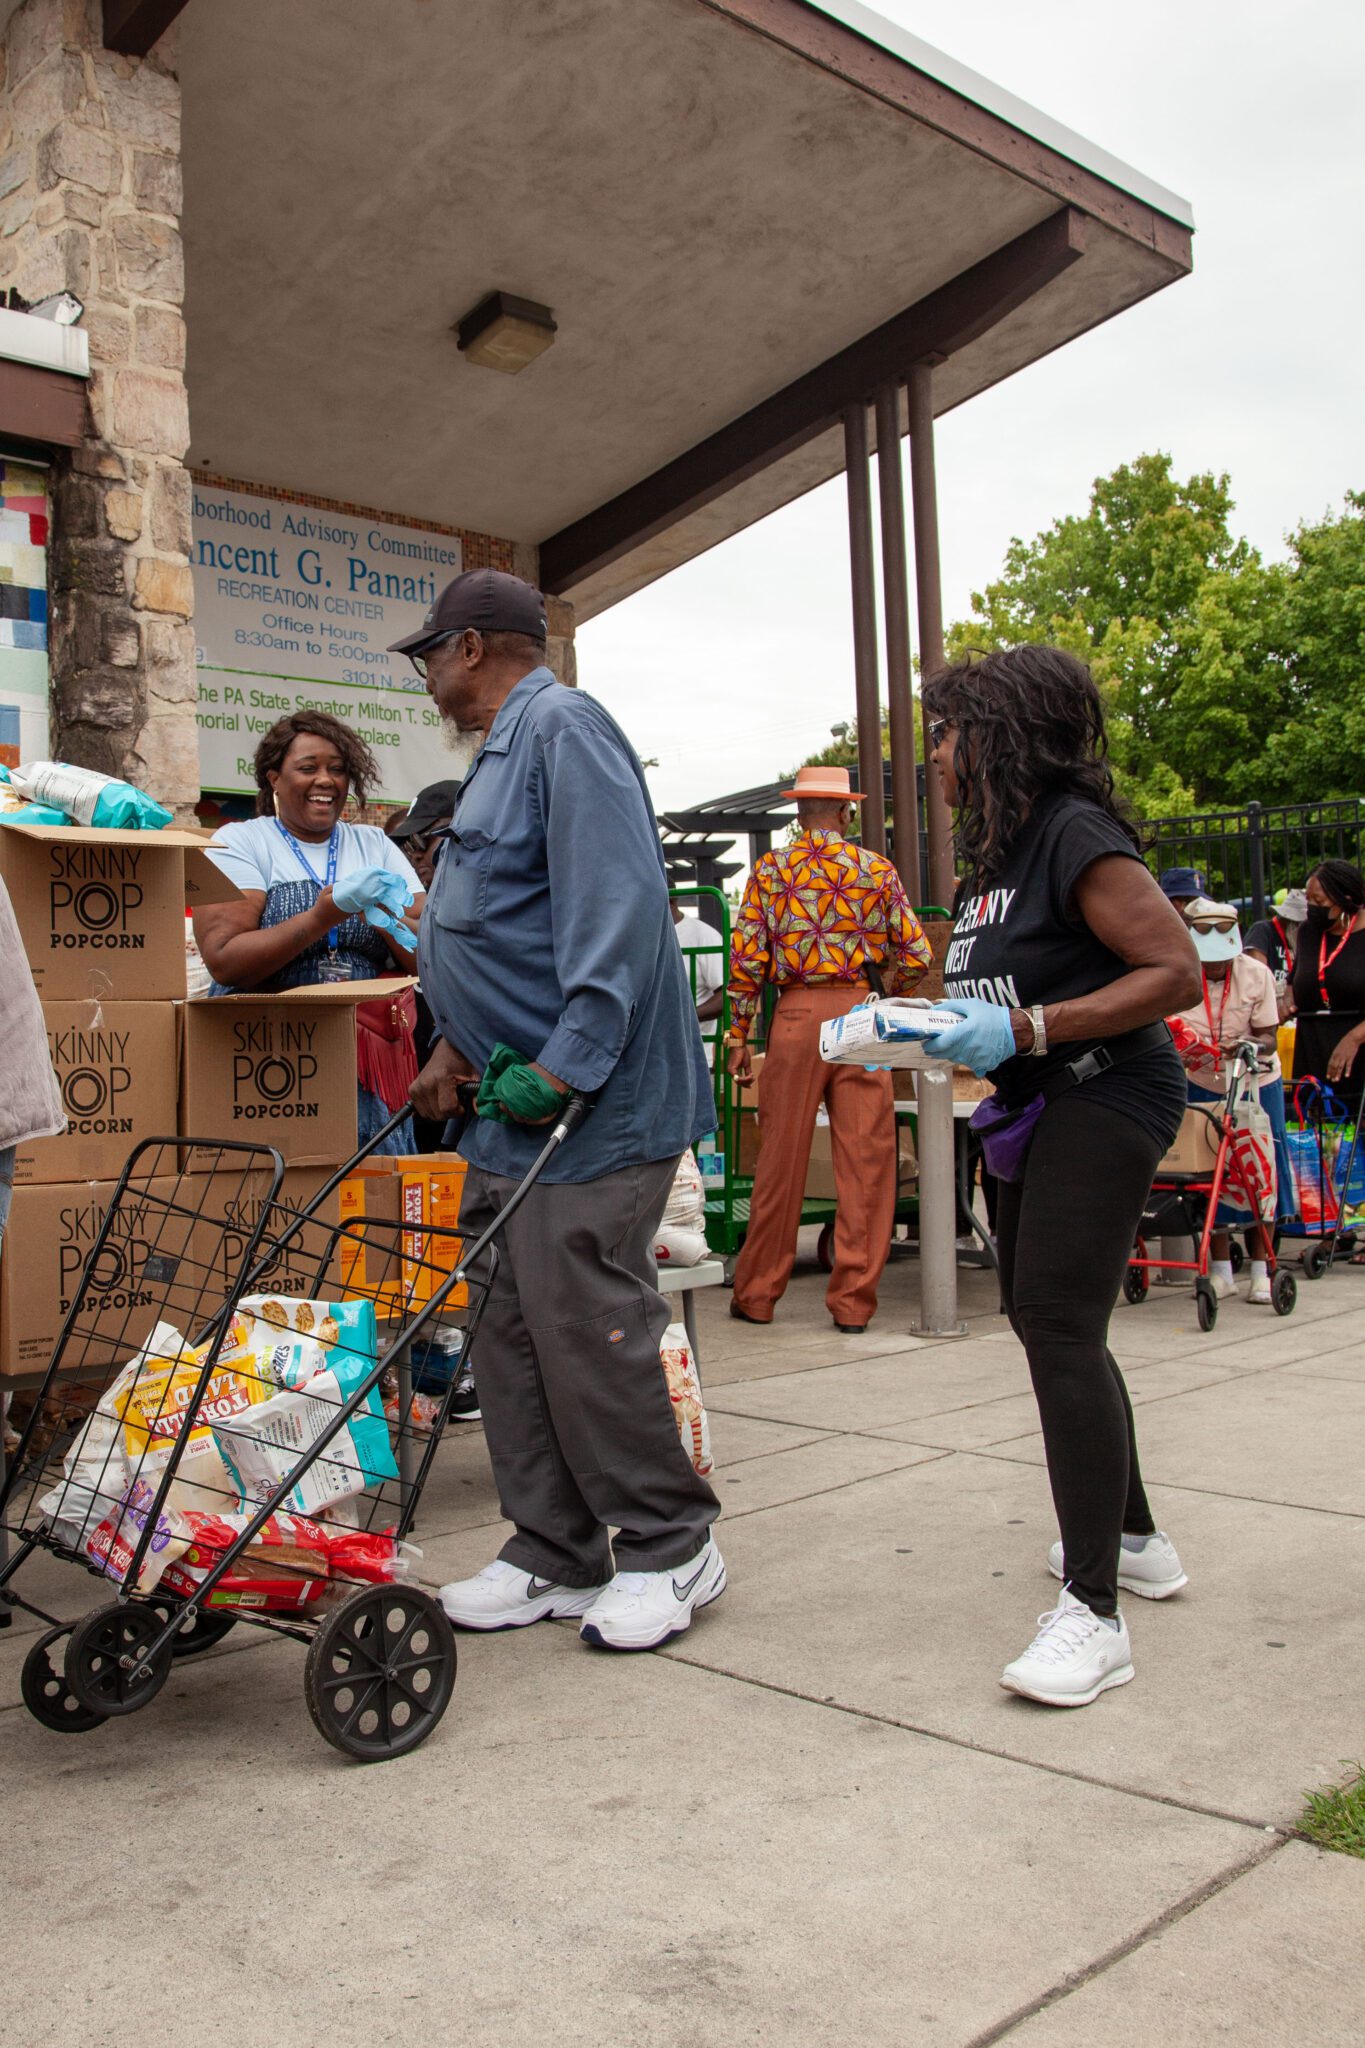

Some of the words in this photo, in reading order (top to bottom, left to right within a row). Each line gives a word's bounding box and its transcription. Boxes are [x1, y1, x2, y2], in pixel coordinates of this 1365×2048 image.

[192, 494, 271, 530] borhood
[282, 514, 359, 550] Advisory
[367, 530, 456, 566] Committee
[297, 549, 332, 588] G.
[347, 557, 435, 605] Panati
[217, 578, 319, 610] RECREATION
[324, 596, 384, 621] CENTER
[262, 613, 314, 635] Office
[320, 622, 369, 643] Hours
[235, 629, 300, 652] 8:30am
[306, 641, 322, 655] to
[328, 643, 389, 665] 5:00pm
[342, 669, 376, 686] 3101
[381, 675, 396, 689] N.
[197, 683, 218, 703] he
[224, 687, 245, 706] PA
[250, 690, 291, 711] State
[295, 696, 354, 717] Senator
[358, 702, 402, 722] Milton
[405, 707, 417, 725] T.
[50, 846, 142, 880] SKINNY
[50, 881, 144, 931] POP
[50, 934, 145, 949] POPCORN
[944, 936, 977, 974] WEST
[822, 1040, 828, 1053] L
[233, 1054, 318, 1102] POP
[56, 1118, 133, 1136] PCORN
[233, 1103, 319, 1119] POPCORN
[346, 1191, 353, 1199] 5
[59, 1239, 151, 1297] POP
[223, 1277, 306, 1299] PPCORN
